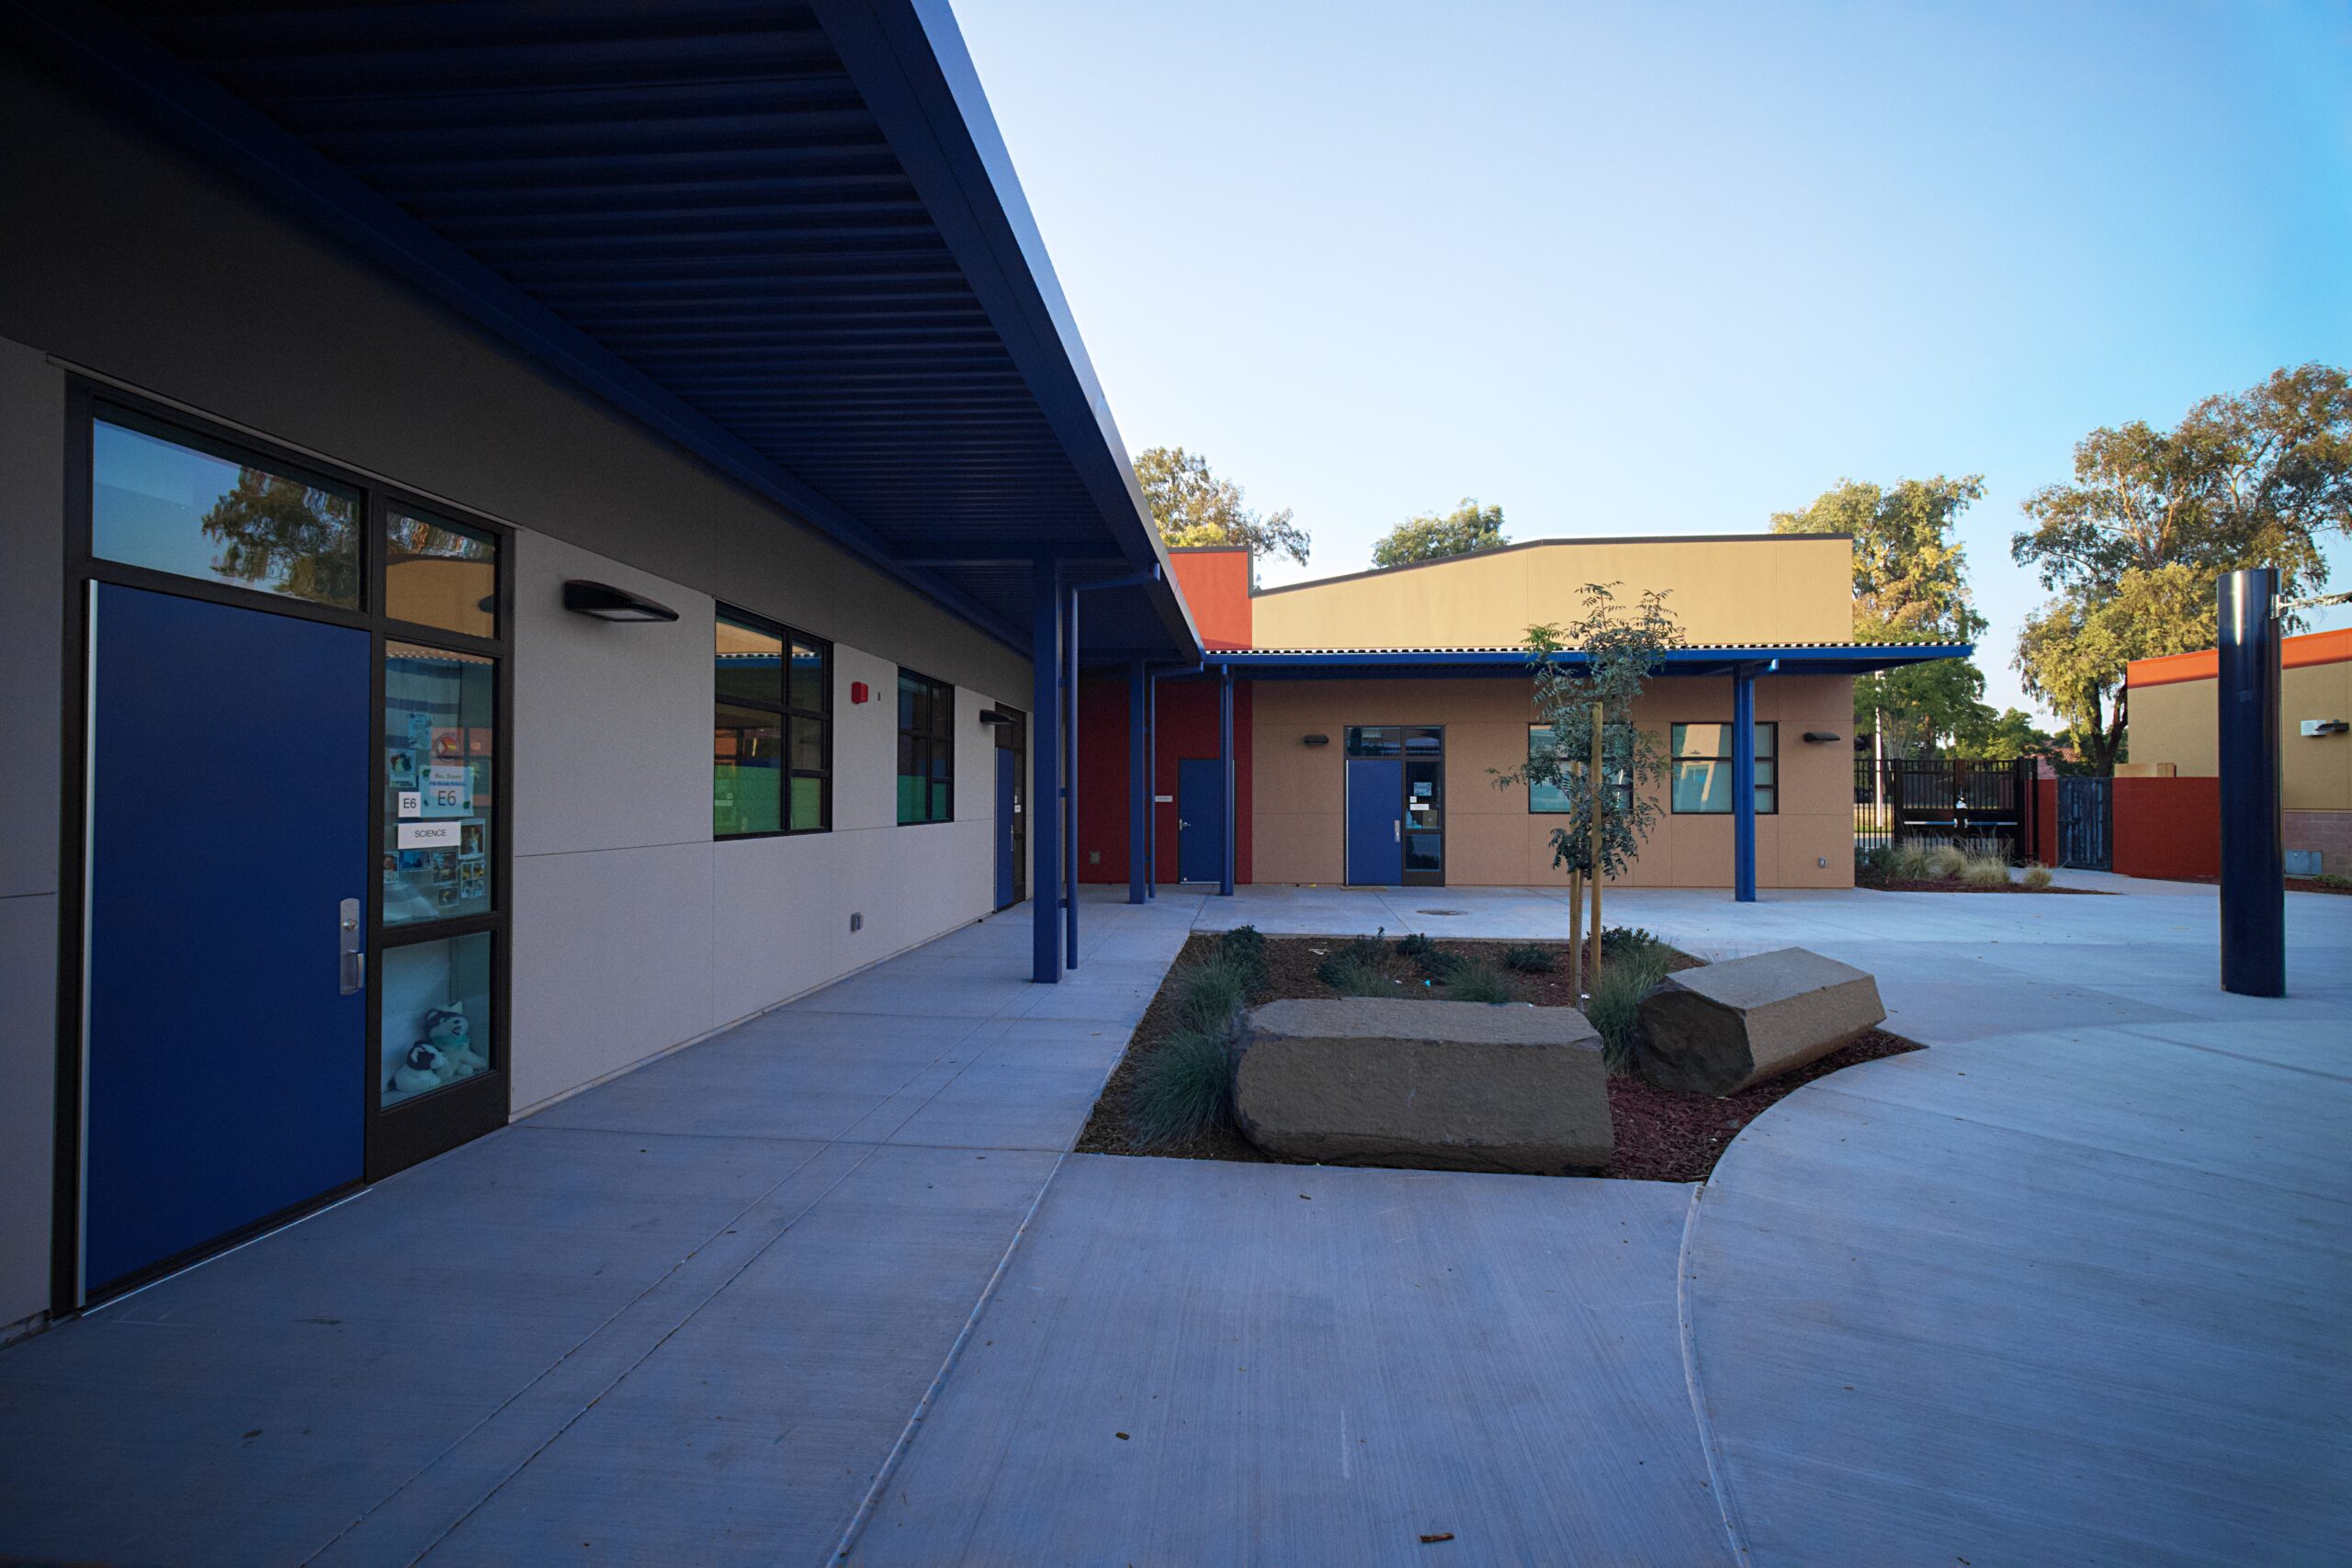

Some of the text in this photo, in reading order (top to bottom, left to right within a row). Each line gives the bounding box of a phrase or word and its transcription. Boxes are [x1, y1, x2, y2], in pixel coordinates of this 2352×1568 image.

[403, 798, 416, 808] E6
[438, 790, 456, 806] E6
[414, 829, 447, 838] SCIENCE
